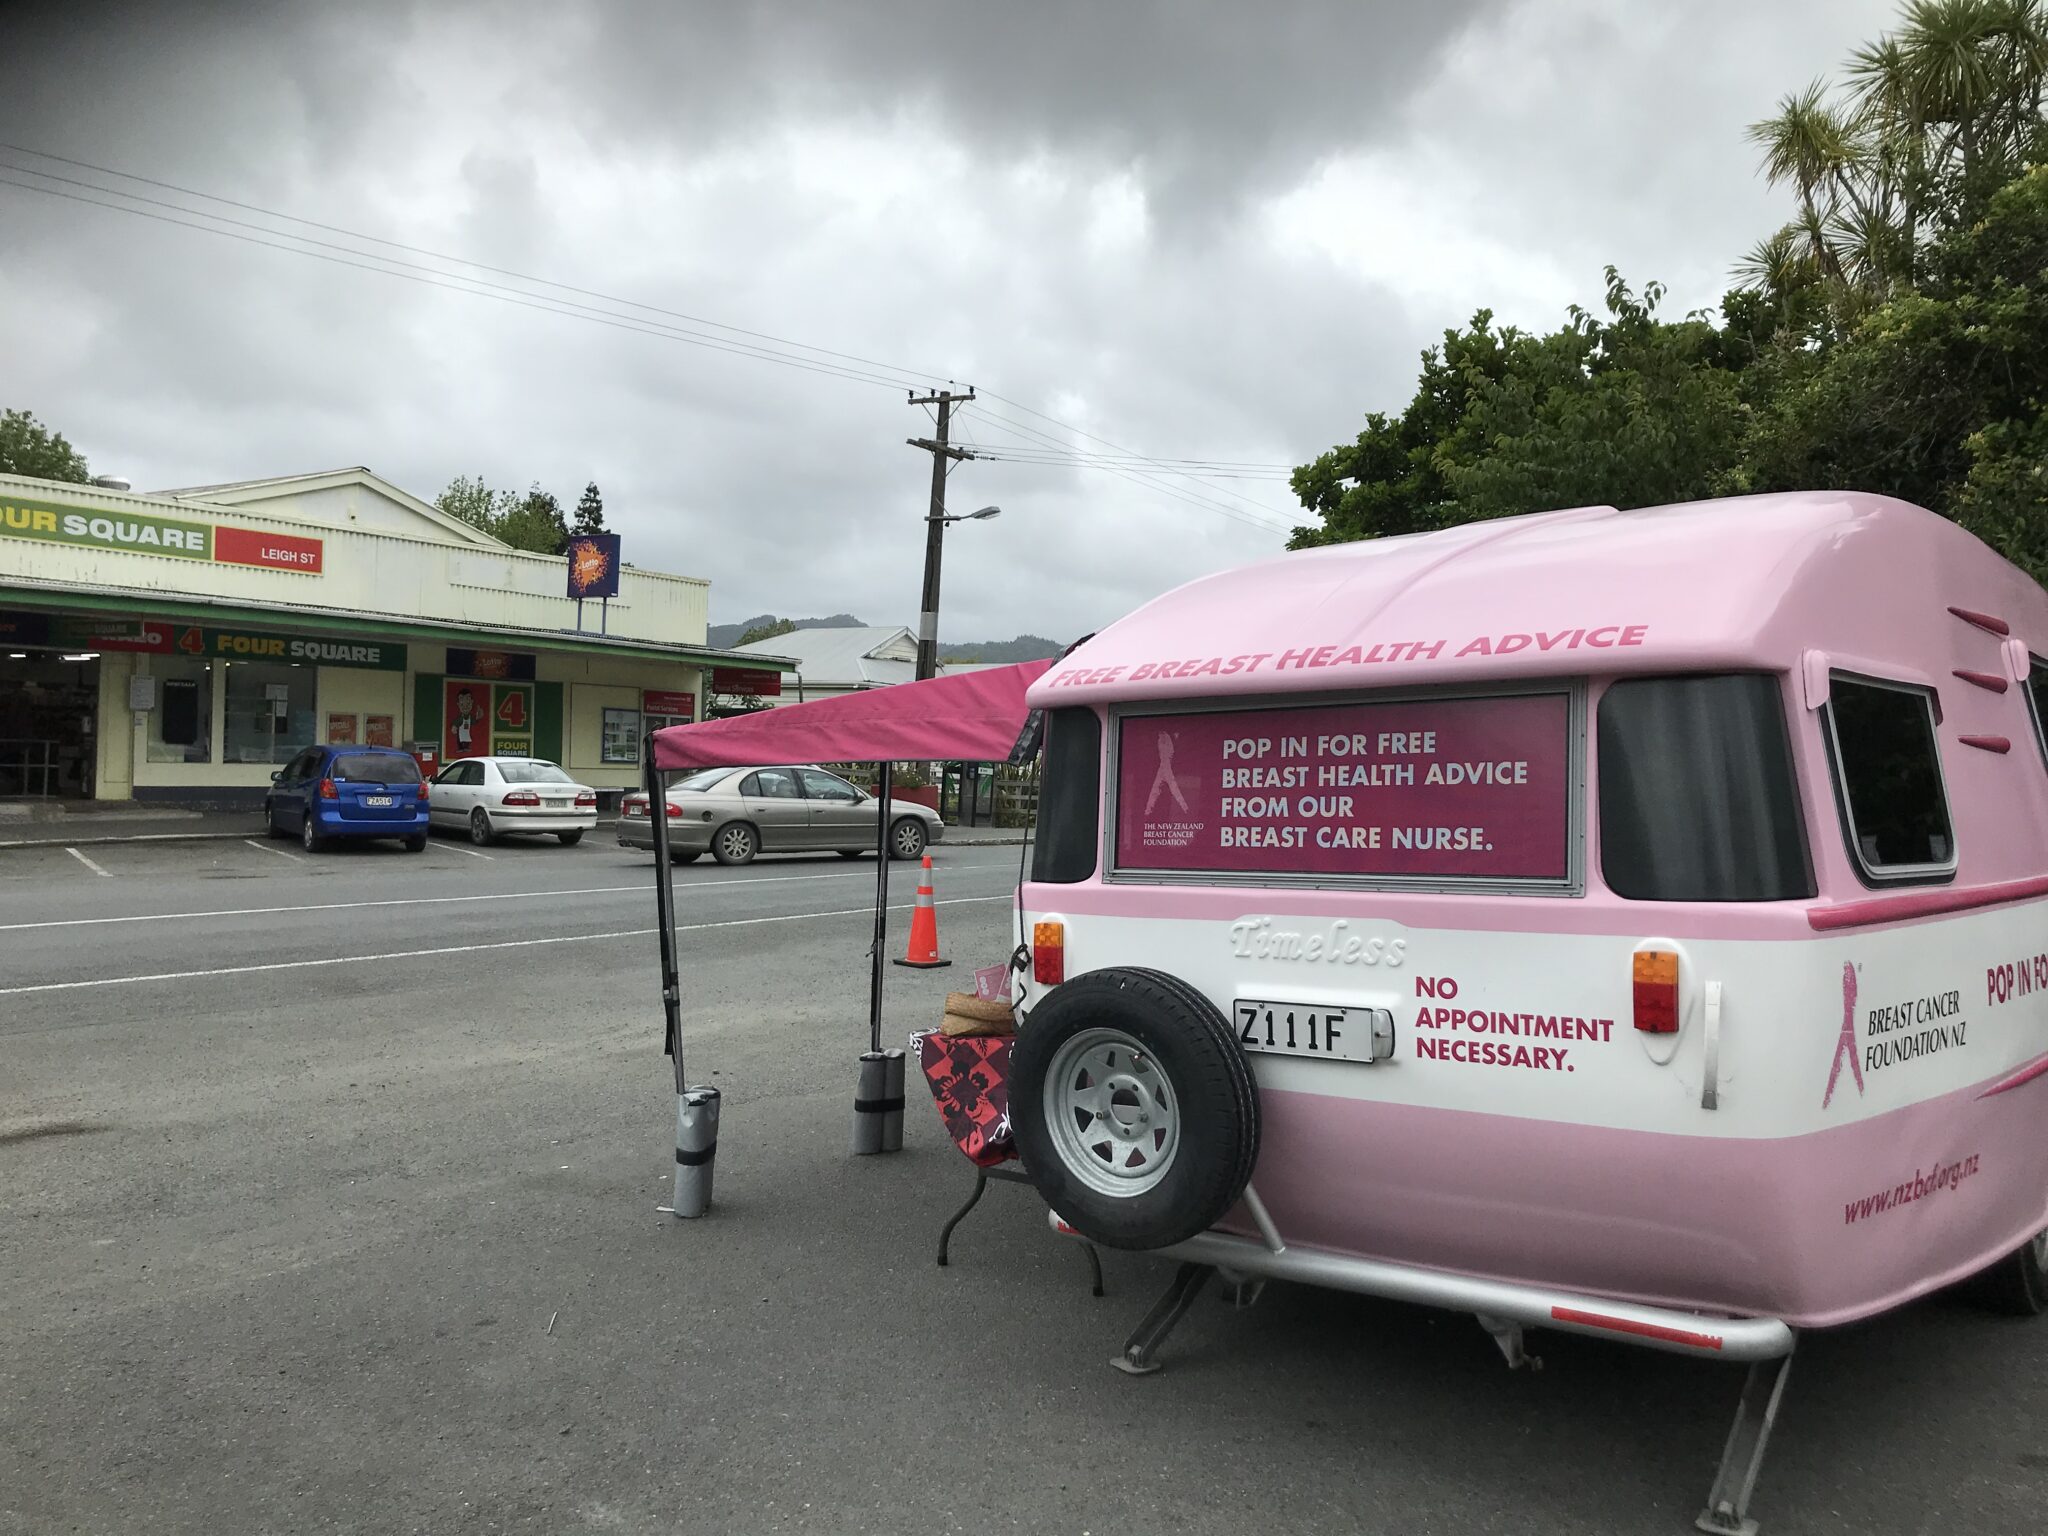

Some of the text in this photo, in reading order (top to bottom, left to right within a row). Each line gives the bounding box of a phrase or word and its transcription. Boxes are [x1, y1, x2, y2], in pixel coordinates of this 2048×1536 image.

[0, 505, 204, 551] UR SQUARE
[261, 547, 316, 564] LEIGH ST
[581, 559, 599, 569] Lotto
[179, 627, 205, 655] 4
[217, 634, 286, 656] FOUR
[290, 640, 380, 663] SQUARE
[1049, 625, 1648, 688] FREE BREAST HEALTH ADVICE
[497, 691, 527, 727] 4
[497, 741, 527, 750] FOUR
[497, 749, 527, 757] SQUARE
[1223, 731, 1436, 760] POP IN FOR FREE
[1222, 761, 1528, 789] BREAST HEALTH ADVICE
[1221, 795, 1354, 818] FROM OUR
[1220, 826, 1493, 851] BREAST CARE NURSE.
[1230, 917, 1407, 967] Timeless
[1416, 976, 1458, 1000] NO
[1987, 953, 2048, 1006] POP IN FO
[1240, 1008, 1344, 1051] Z111F
[1415, 1006, 1614, 1042] APPOINTMENT
[1868, 990, 1960, 1036] BREAST CANCER
[1416, 1037, 1575, 1072] NECESSARY.
[1865, 1021, 1966, 1072] FOUNDATION NZ
